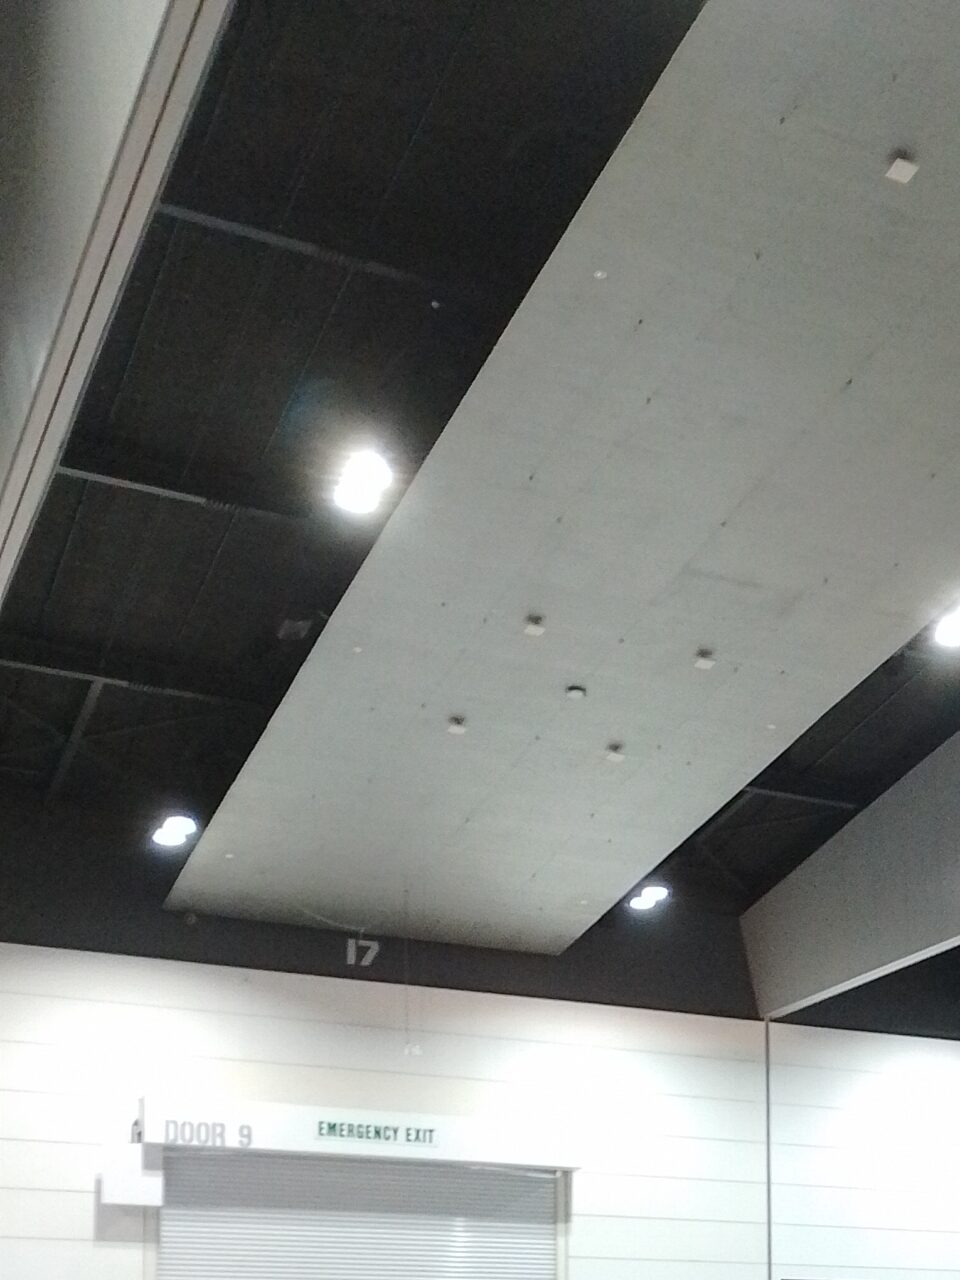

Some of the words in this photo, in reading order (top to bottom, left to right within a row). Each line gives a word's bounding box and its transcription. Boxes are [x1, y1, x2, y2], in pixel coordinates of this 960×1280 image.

[347, 938, 379, 966] 17
[164, 1119, 226, 1147] DOOR
[239, 1125, 253, 1147] 9
[318, 1120, 399, 1142] EMERGENCY
[405, 1127, 436, 1145] EXIT
